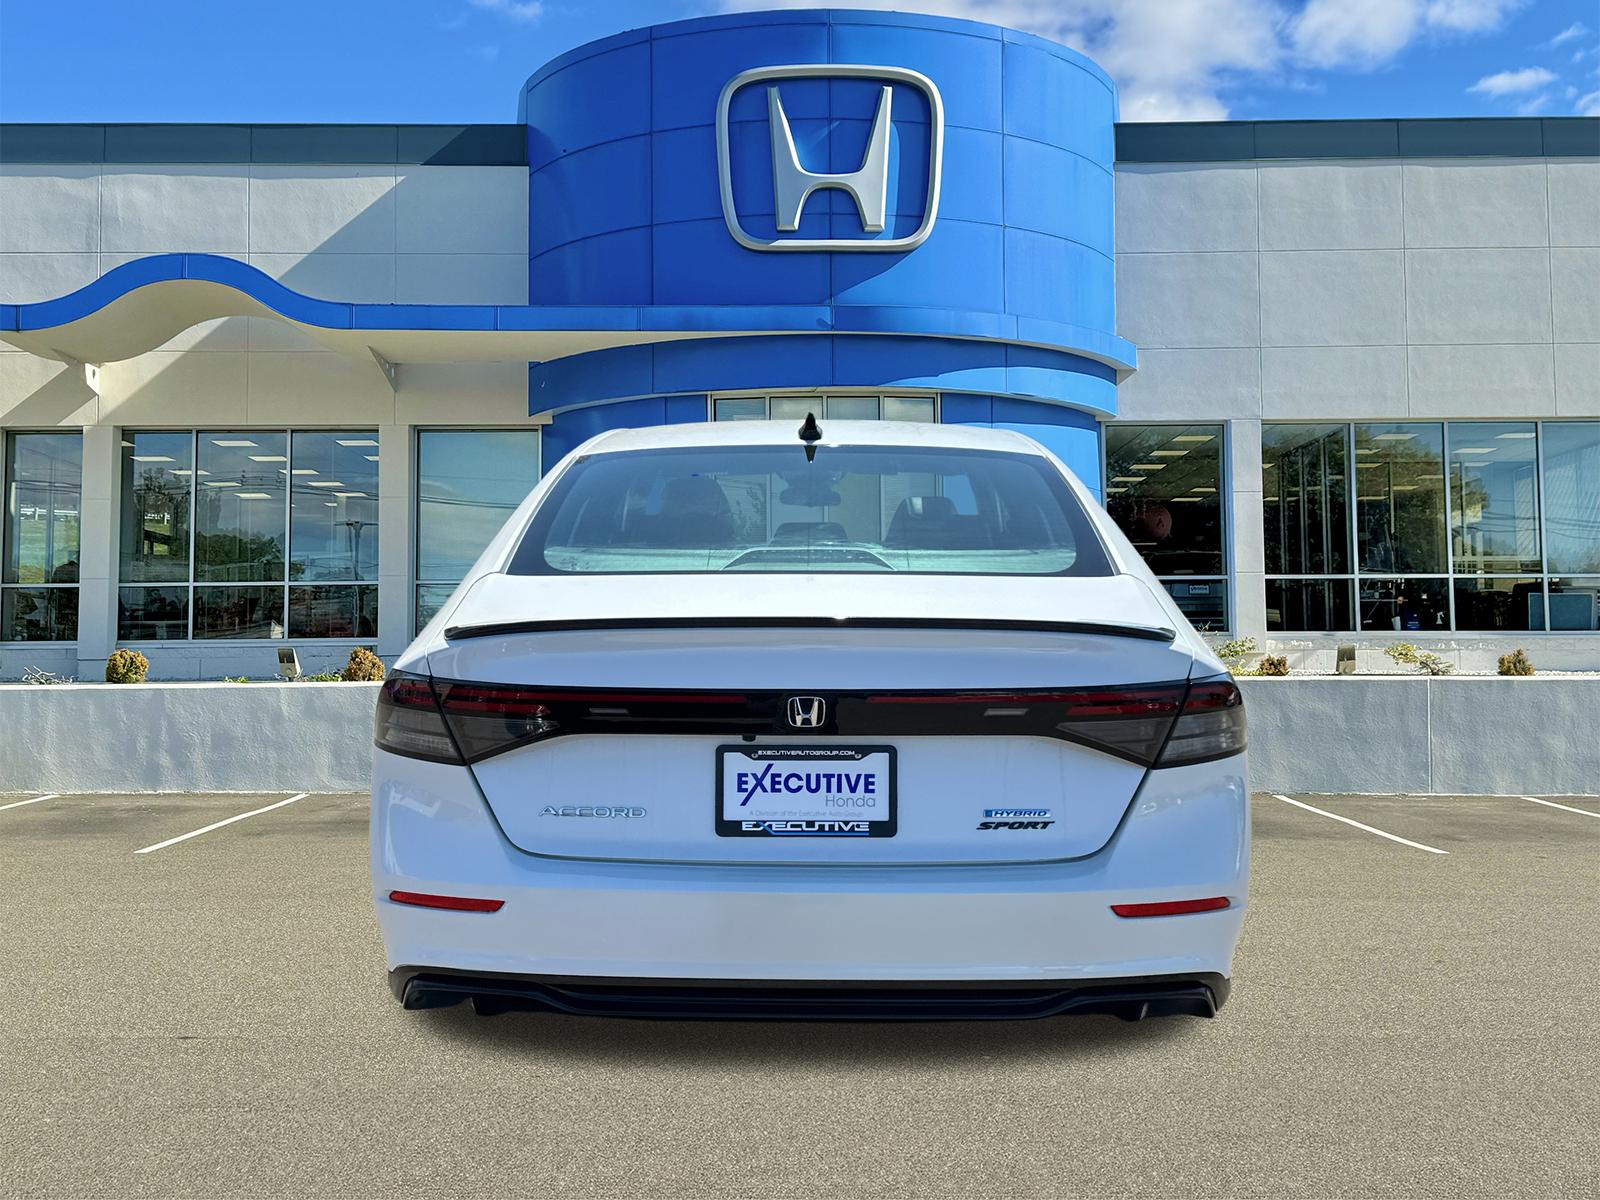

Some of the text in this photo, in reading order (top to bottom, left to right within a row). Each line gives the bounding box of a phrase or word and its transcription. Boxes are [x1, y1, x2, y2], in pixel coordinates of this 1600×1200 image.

[736, 763, 876, 806] EXECUTIVE
[825, 795, 876, 808] Honda
[539, 806, 647, 819] ACCORD
[993, 809, 1048, 817] HYBRID
[742, 821, 870, 832] EXECUTIVE
[976, 821, 1055, 830] SPORT
